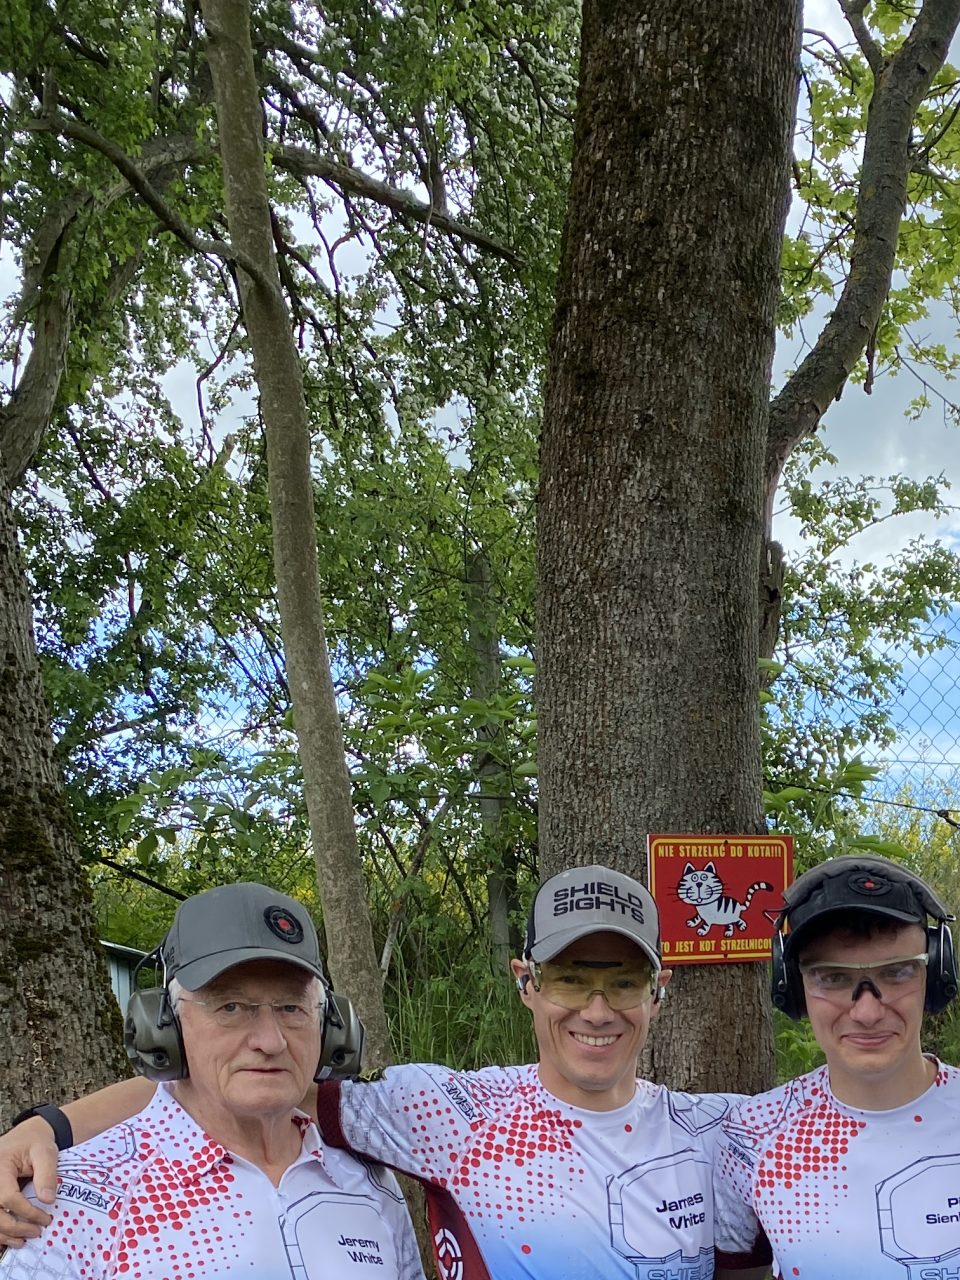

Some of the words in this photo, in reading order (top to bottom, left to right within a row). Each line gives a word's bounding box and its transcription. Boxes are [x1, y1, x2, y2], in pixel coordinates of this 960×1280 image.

[658, 845, 674, 858] NIE
[679, 843, 726, 858] STRZELAĆ
[730, 845, 743, 858] DO
[748, 845, 782, 858] KOTA!!!
[553, 881, 643, 909] SHIELD
[553, 896, 645, 925] SIGHTS
[675, 941, 695, 953] JEST
[699, 940, 717, 952] KOT
[721, 938, 772, 951] STRZELNICO
[655, 1193, 704, 1213] James
[338, 1234, 380, 1252] Jeremy
[347, 1251, 384, 1265] White
